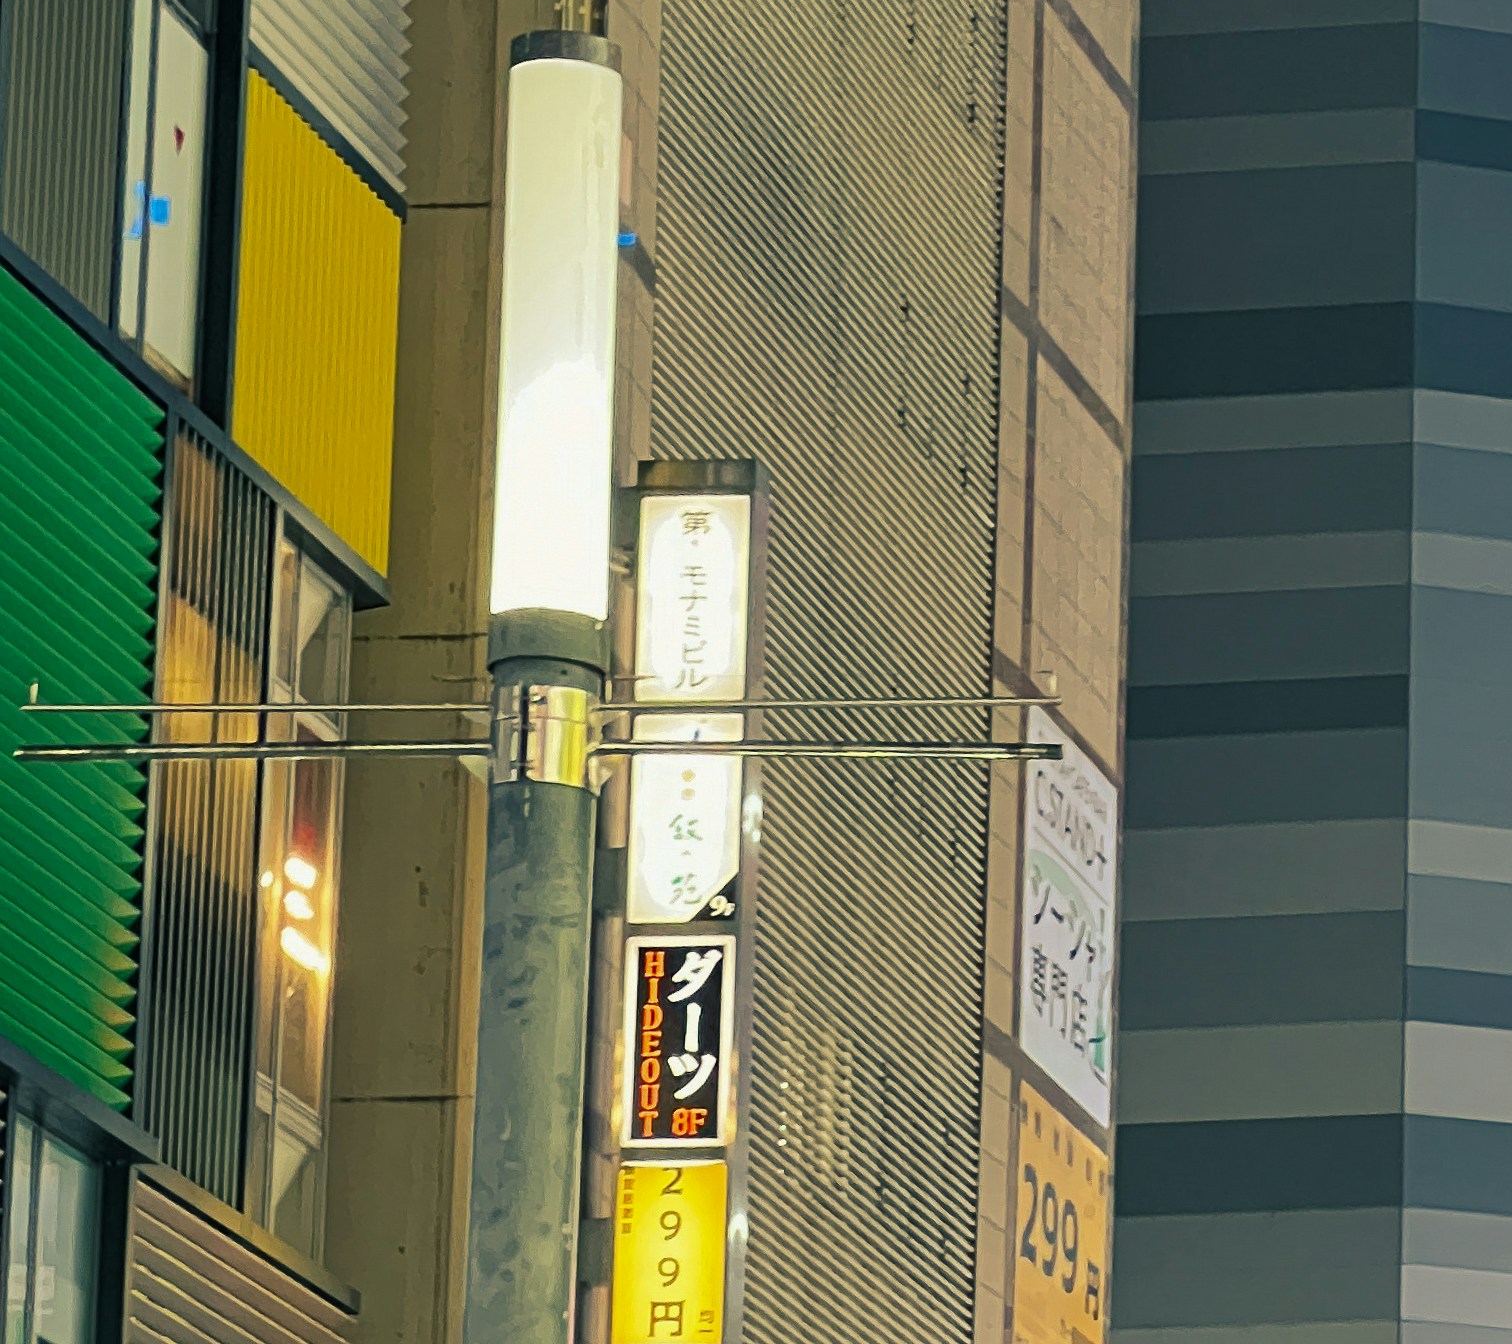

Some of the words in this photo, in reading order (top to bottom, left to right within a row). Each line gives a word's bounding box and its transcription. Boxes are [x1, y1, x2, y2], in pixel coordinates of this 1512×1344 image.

[674, 511, 713, 689] 第モナミビル
[638, 951, 666, 1138] HIDEOUT
[671, 1107, 708, 1136] 8F
